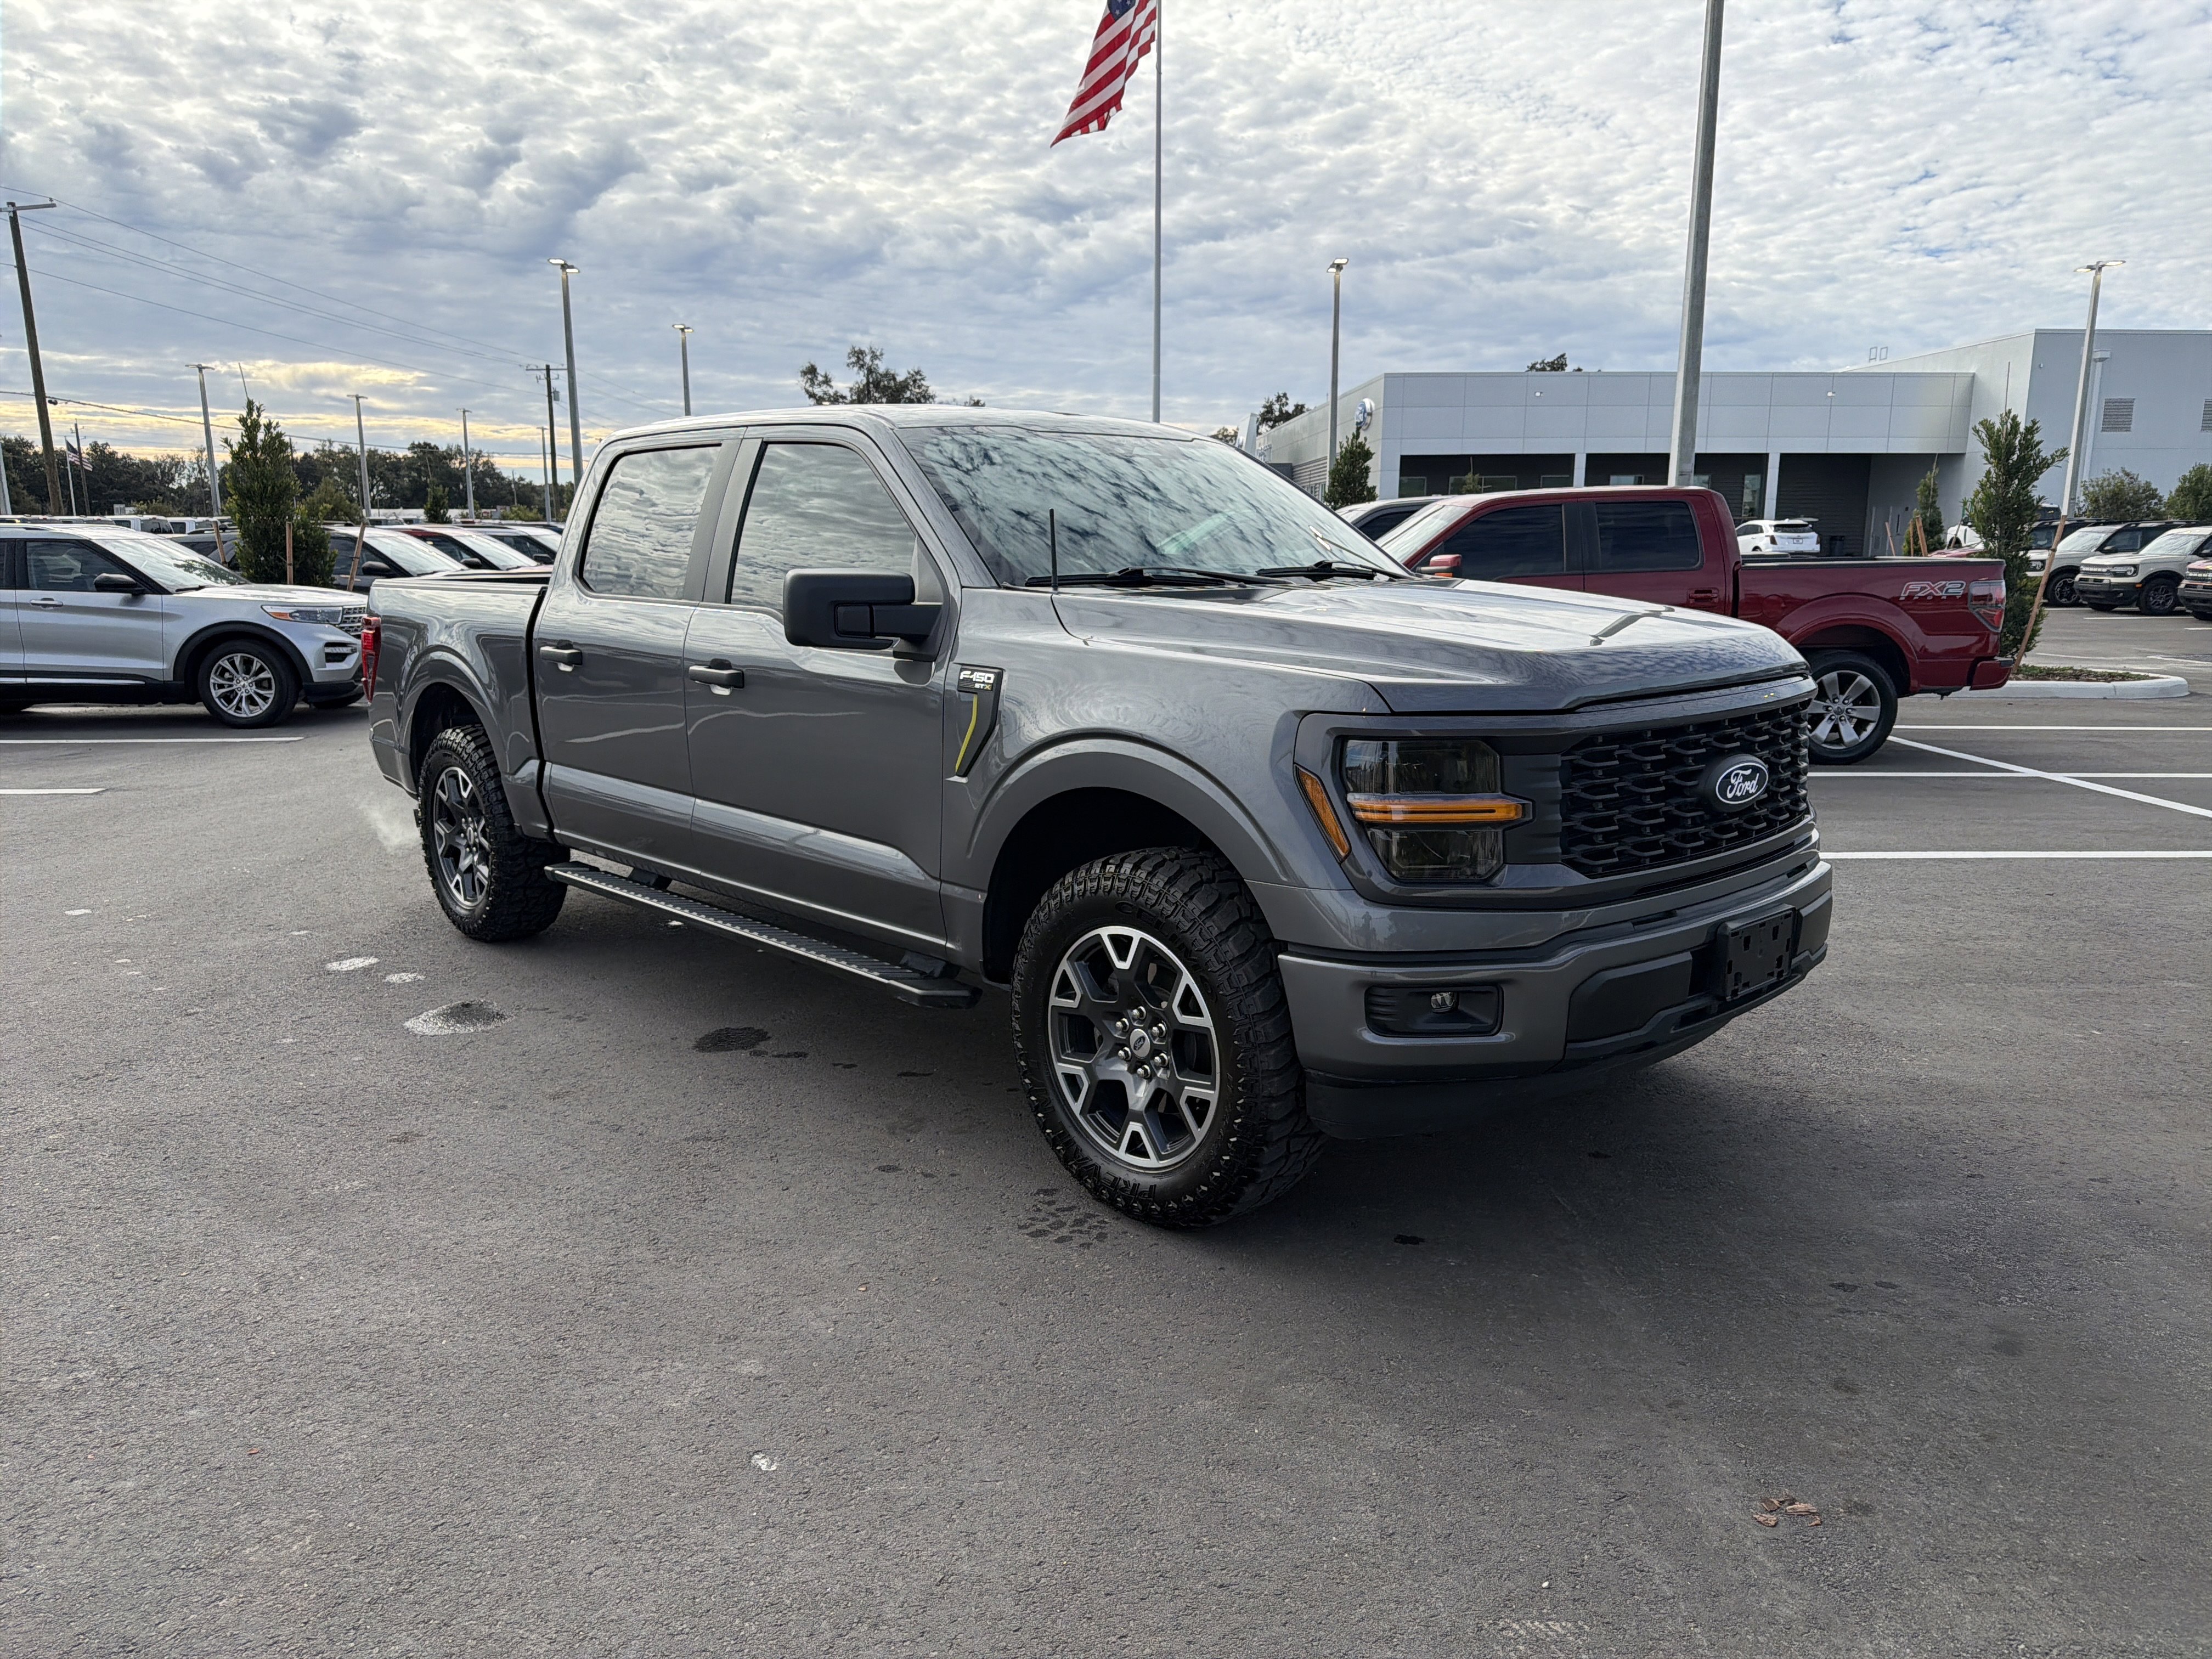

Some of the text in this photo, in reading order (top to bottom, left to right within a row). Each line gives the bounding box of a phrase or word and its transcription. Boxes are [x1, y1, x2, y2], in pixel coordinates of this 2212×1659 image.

[1901, 581, 1966, 596] FX2
[960, 670, 995, 683] F-150
[1727, 769, 1759, 798] Ford
[1052, 1120, 1156, 1200] PREVAIL
